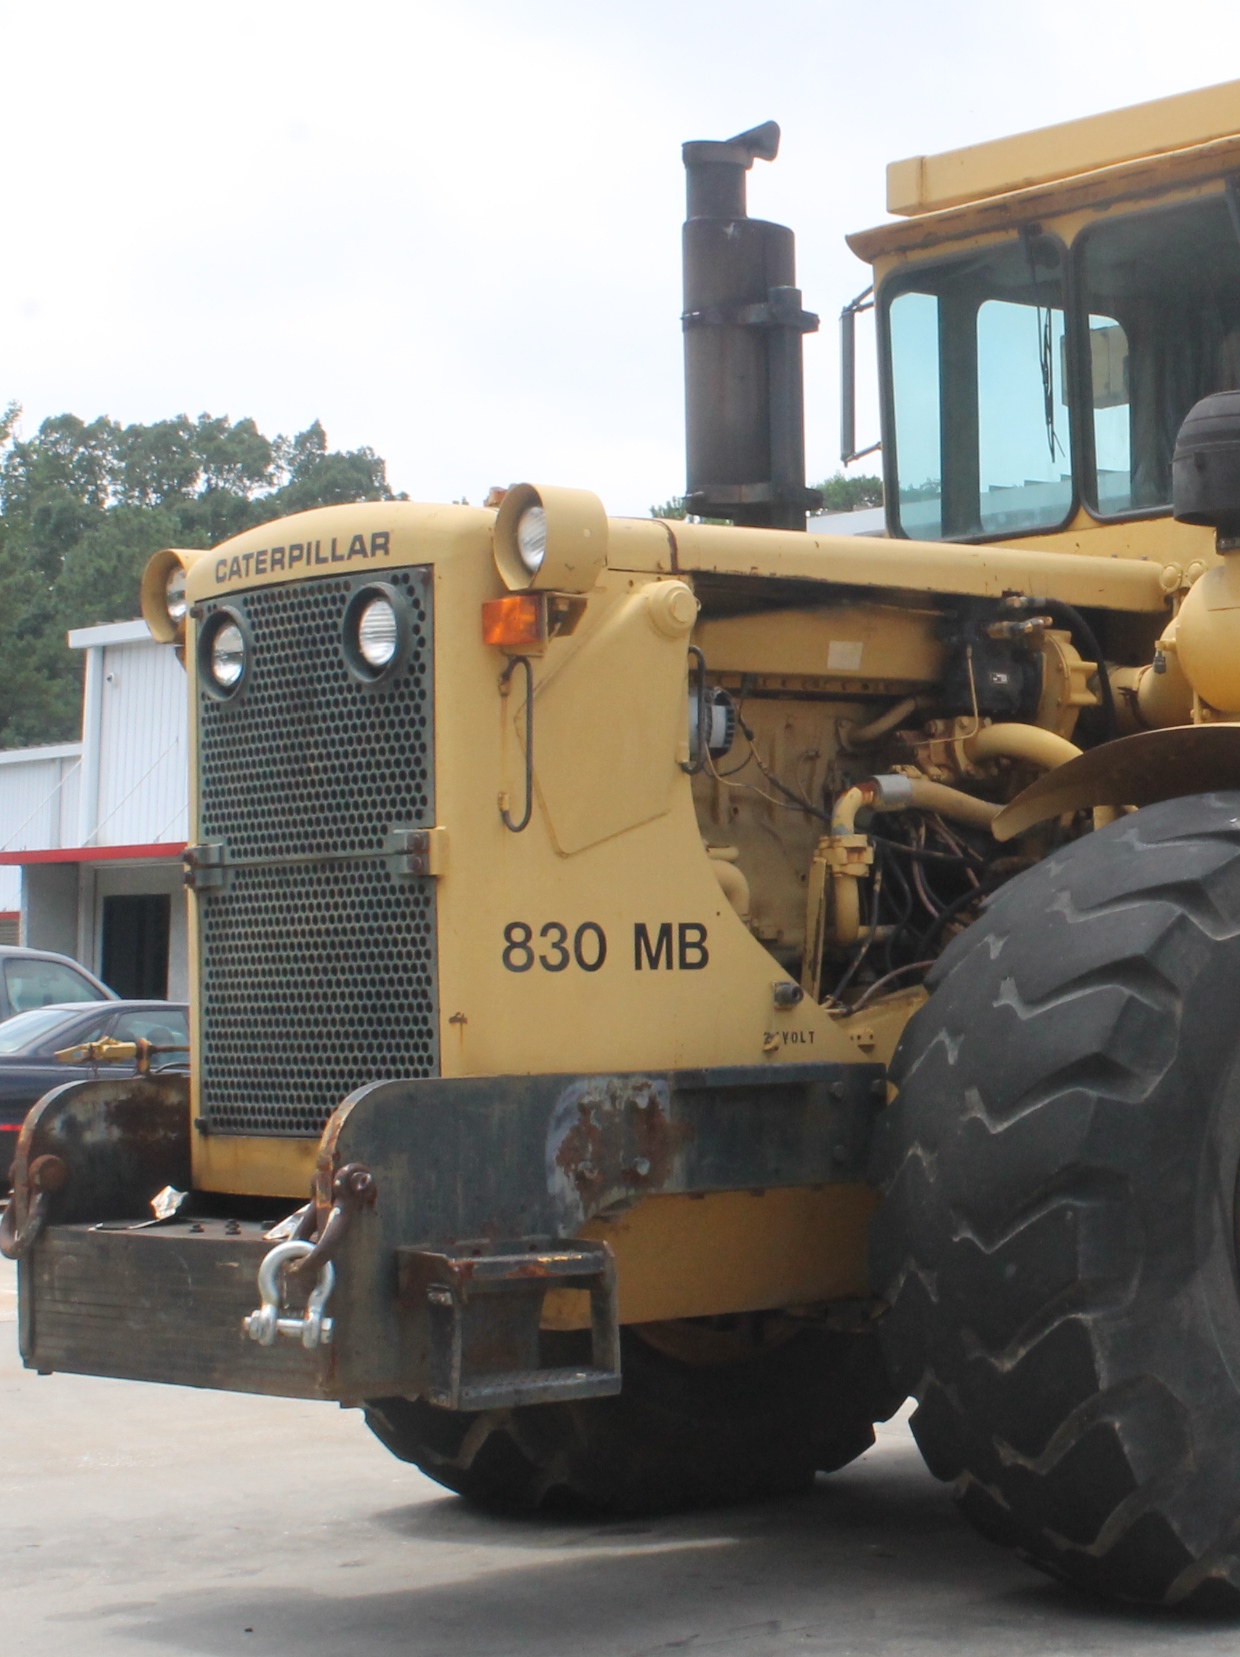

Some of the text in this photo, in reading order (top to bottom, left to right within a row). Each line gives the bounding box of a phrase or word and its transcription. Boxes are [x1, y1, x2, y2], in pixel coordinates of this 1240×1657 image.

[215, 531, 390, 583] CATERPILLAR
[502, 921, 709, 973] 830 MB
